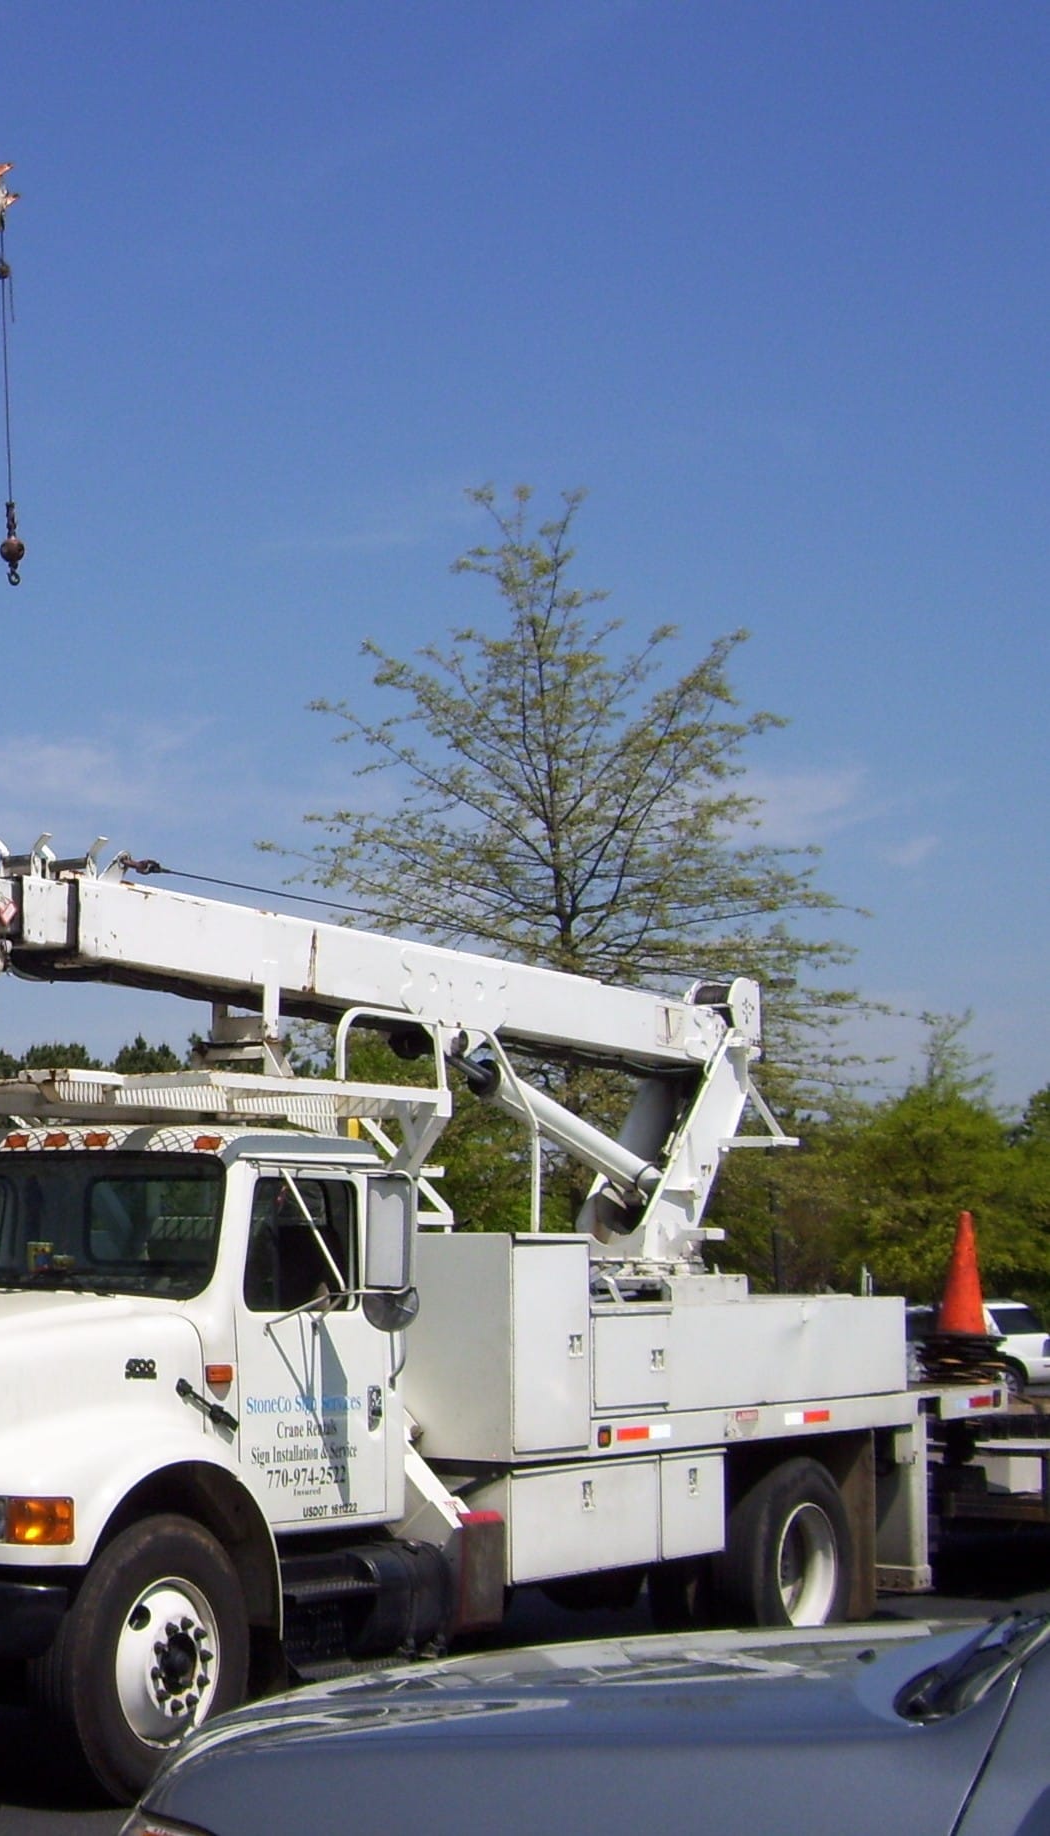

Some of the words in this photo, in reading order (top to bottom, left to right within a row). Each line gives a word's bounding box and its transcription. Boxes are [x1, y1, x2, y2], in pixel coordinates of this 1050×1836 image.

[246, 1396, 292, 1416] StoneCo
[294, 1393, 317, 1416] Sign
[276, 1421, 304, 1439] Crane
[306, 1418, 338, 1438] Rentals
[251, 1446, 270, 1468] Sign
[272, 1444, 319, 1463] Installation
[329, 1442, 358, 1460] Service
[266, 1465, 347, 1489] 770-974-2522
[292, 1487, 322, 1497] Insured
[302, 1504, 328, 1518] USDOT
